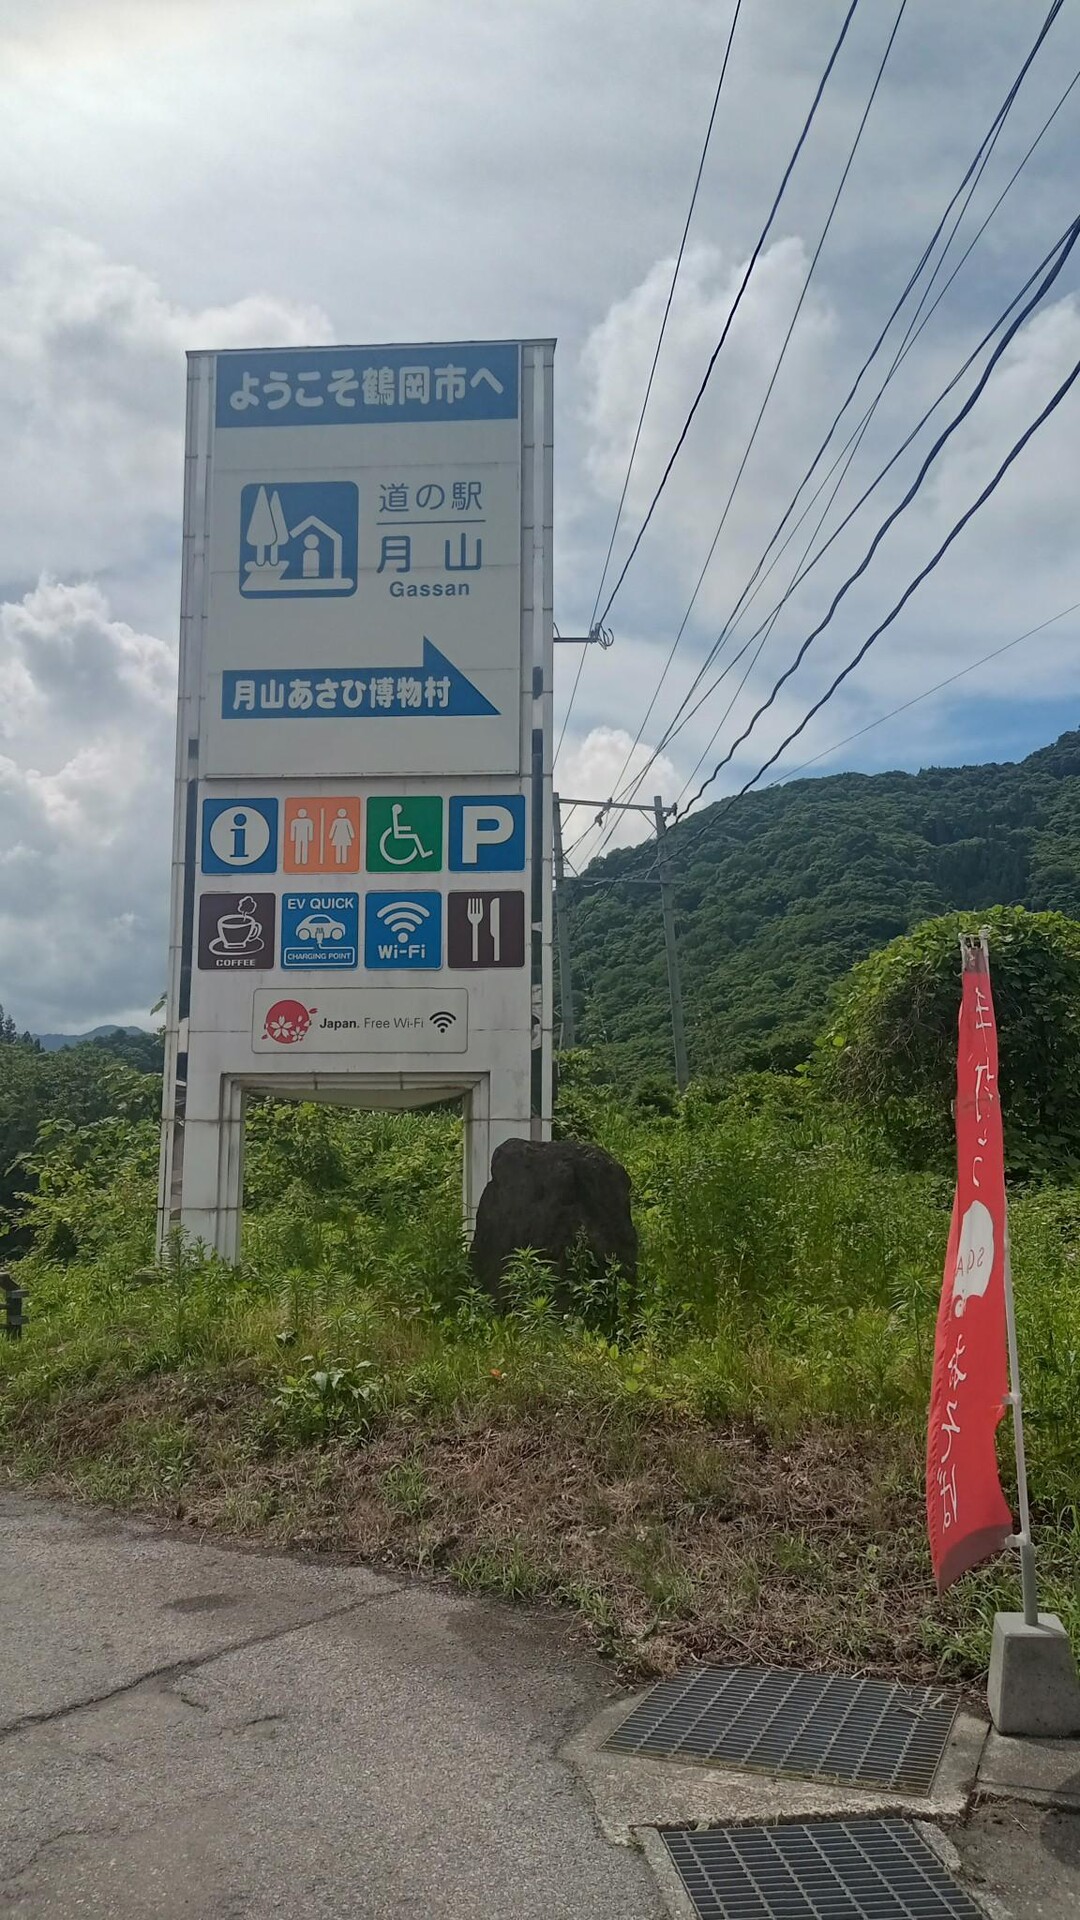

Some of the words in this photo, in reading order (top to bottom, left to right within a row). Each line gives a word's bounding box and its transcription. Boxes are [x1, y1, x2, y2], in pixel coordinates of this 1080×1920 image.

[229, 364, 504, 411] ようこそ鶴岡市へ
[378, 481, 483, 513] 道の駅
[376, 532, 483, 574] 月山
[389, 580, 471, 598] Gassan
[233, 676, 451, 711] 月山あさひ博物村
[461, 805, 515, 864] P
[287, 898, 305, 910] EV
[309, 897, 354, 910] QUICK
[287, 953, 327, 962] CHARGING
[327, 952, 352, 961] POINT
[378, 944, 427, 960] Wi-Fi
[215, 958, 256, 967] COFFEE
[319, 1017, 361, 1031] Japan.
[363, 1017, 391, 1030] Free
[393, 1017, 425, 1030] Wi-Fi
